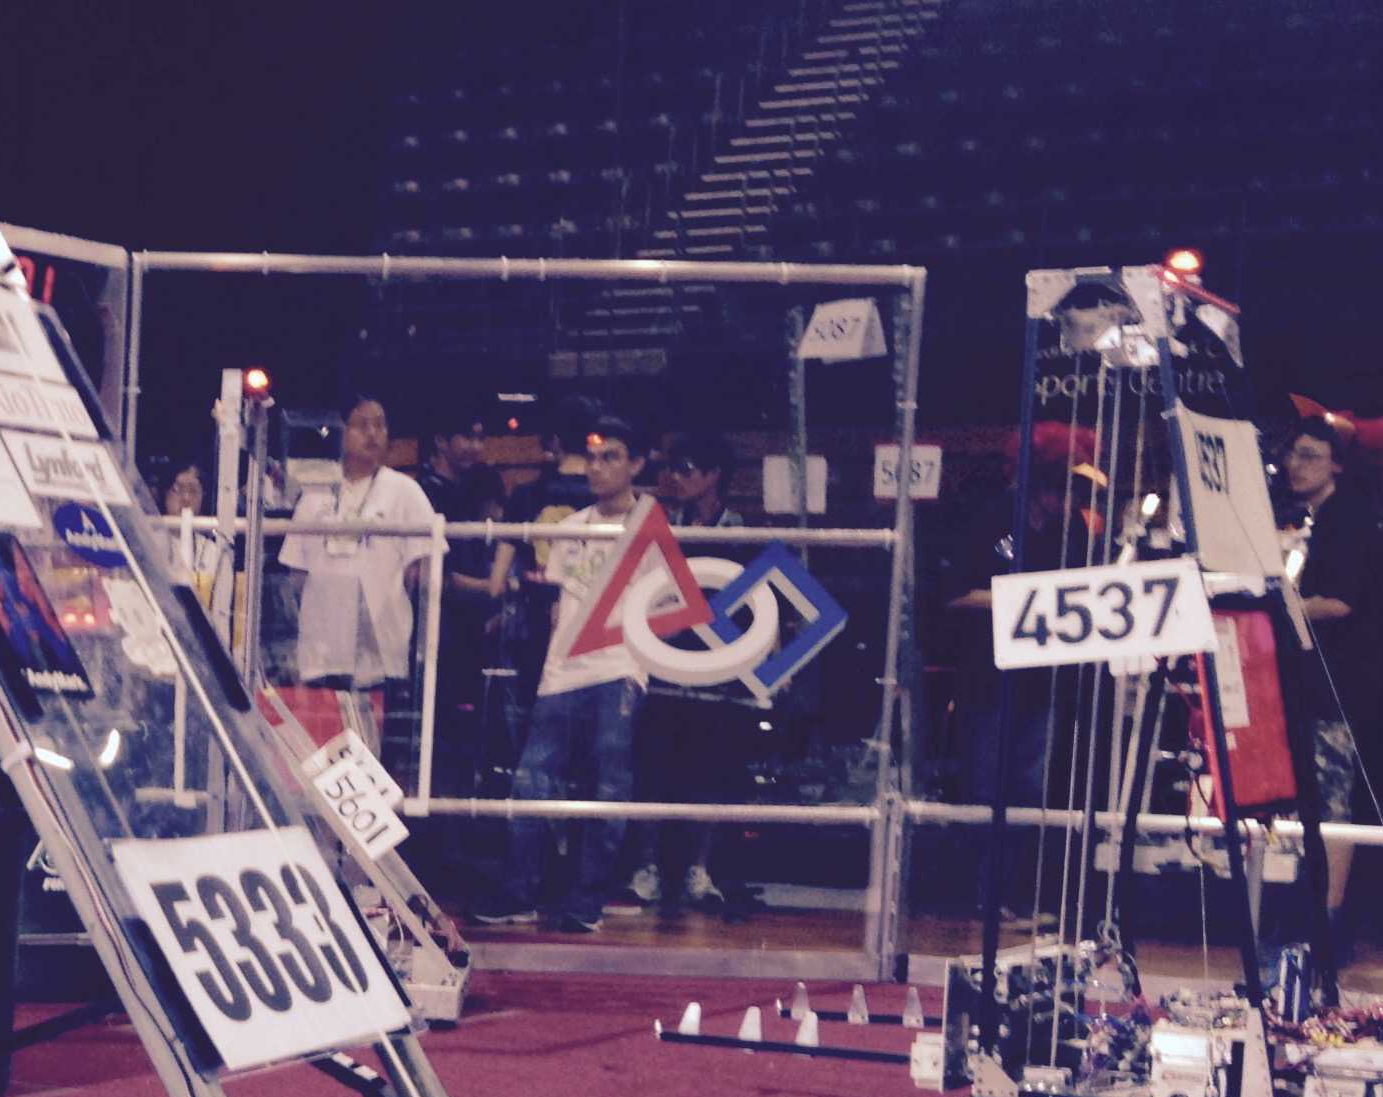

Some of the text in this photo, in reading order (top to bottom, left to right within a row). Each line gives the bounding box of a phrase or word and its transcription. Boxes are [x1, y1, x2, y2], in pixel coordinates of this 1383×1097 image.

[882, 459, 935, 486] 587
[1011, 576, 1180, 646] 4537
[324, 774, 390, 844] 5601
[150, 862, 370, 1021] 5333
